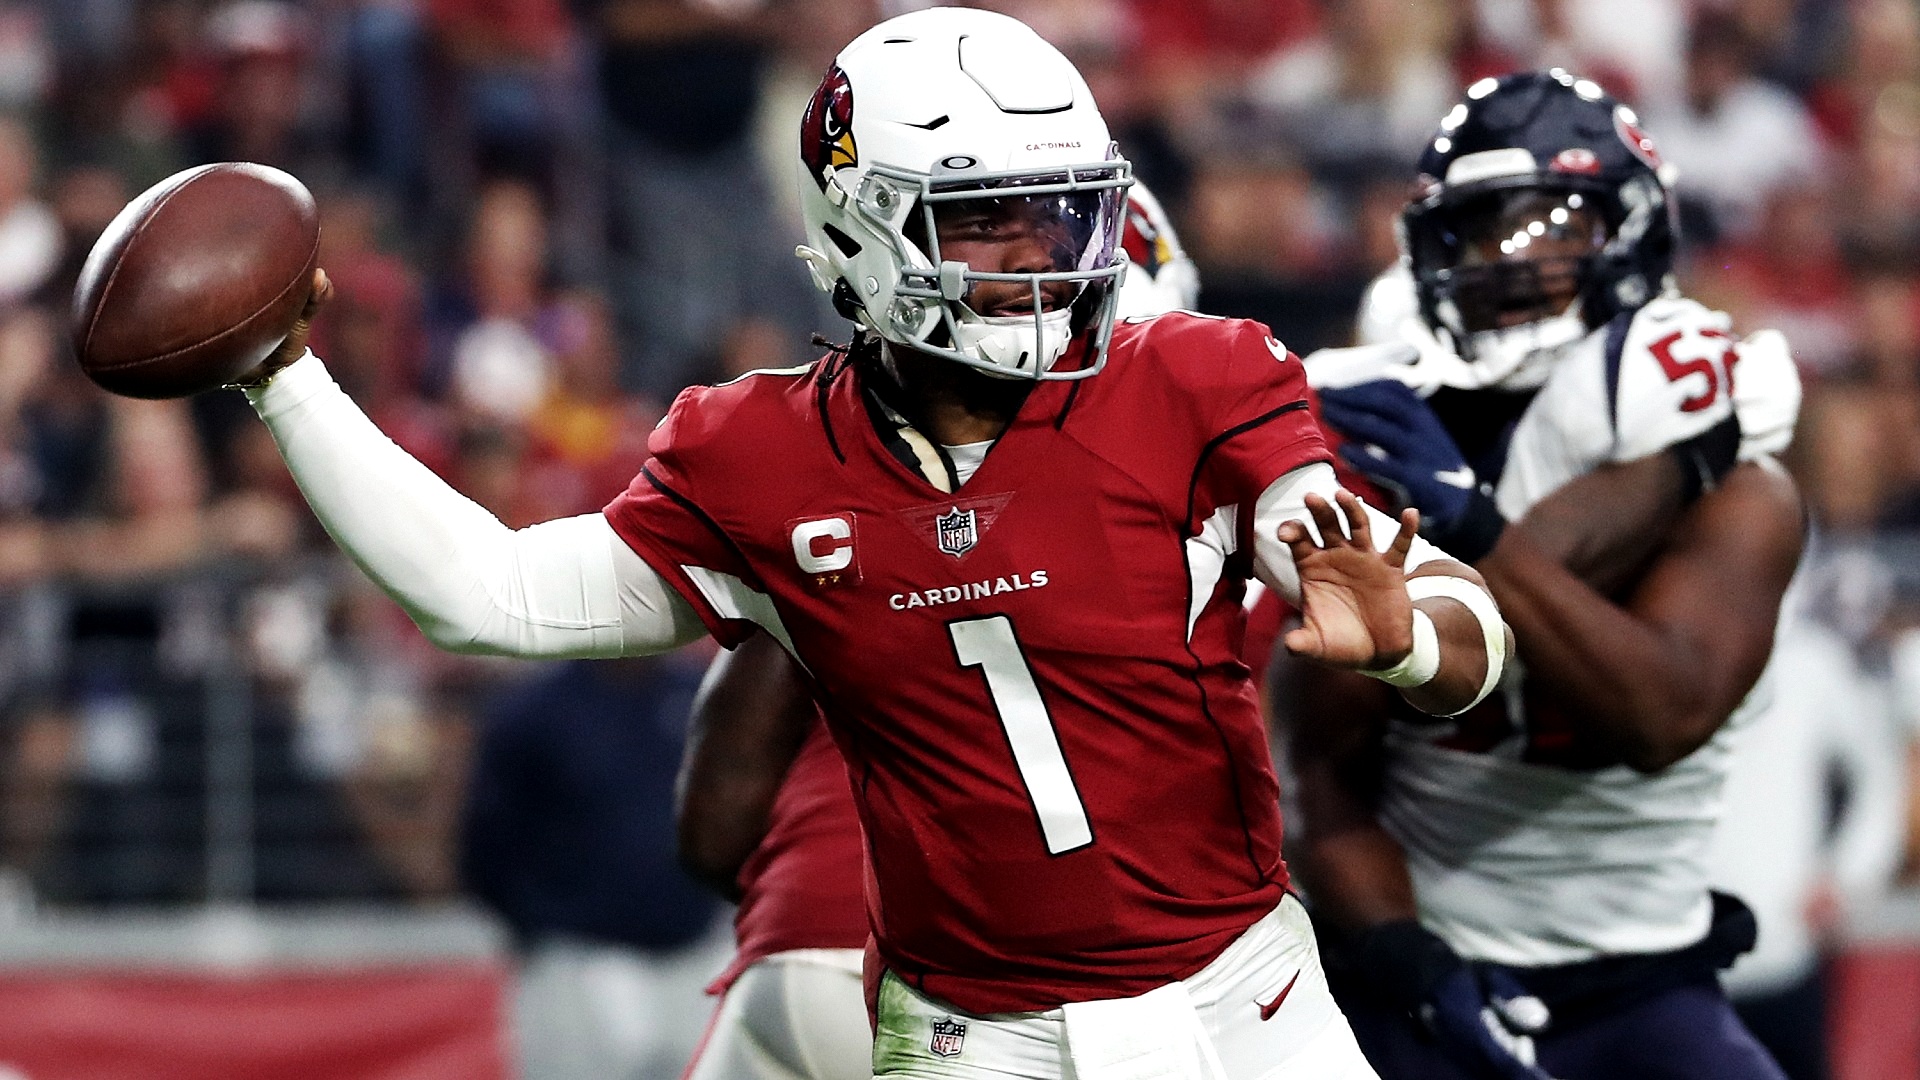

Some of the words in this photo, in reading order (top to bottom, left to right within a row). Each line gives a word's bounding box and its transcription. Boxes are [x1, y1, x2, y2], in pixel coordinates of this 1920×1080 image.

[791, 517, 854, 574] C
[943, 528, 971, 549] NFL
[889, 570, 1049, 610] CARDINALS
[947, 614, 1094, 856] 1
[933, 1034, 959, 1054] NFL
